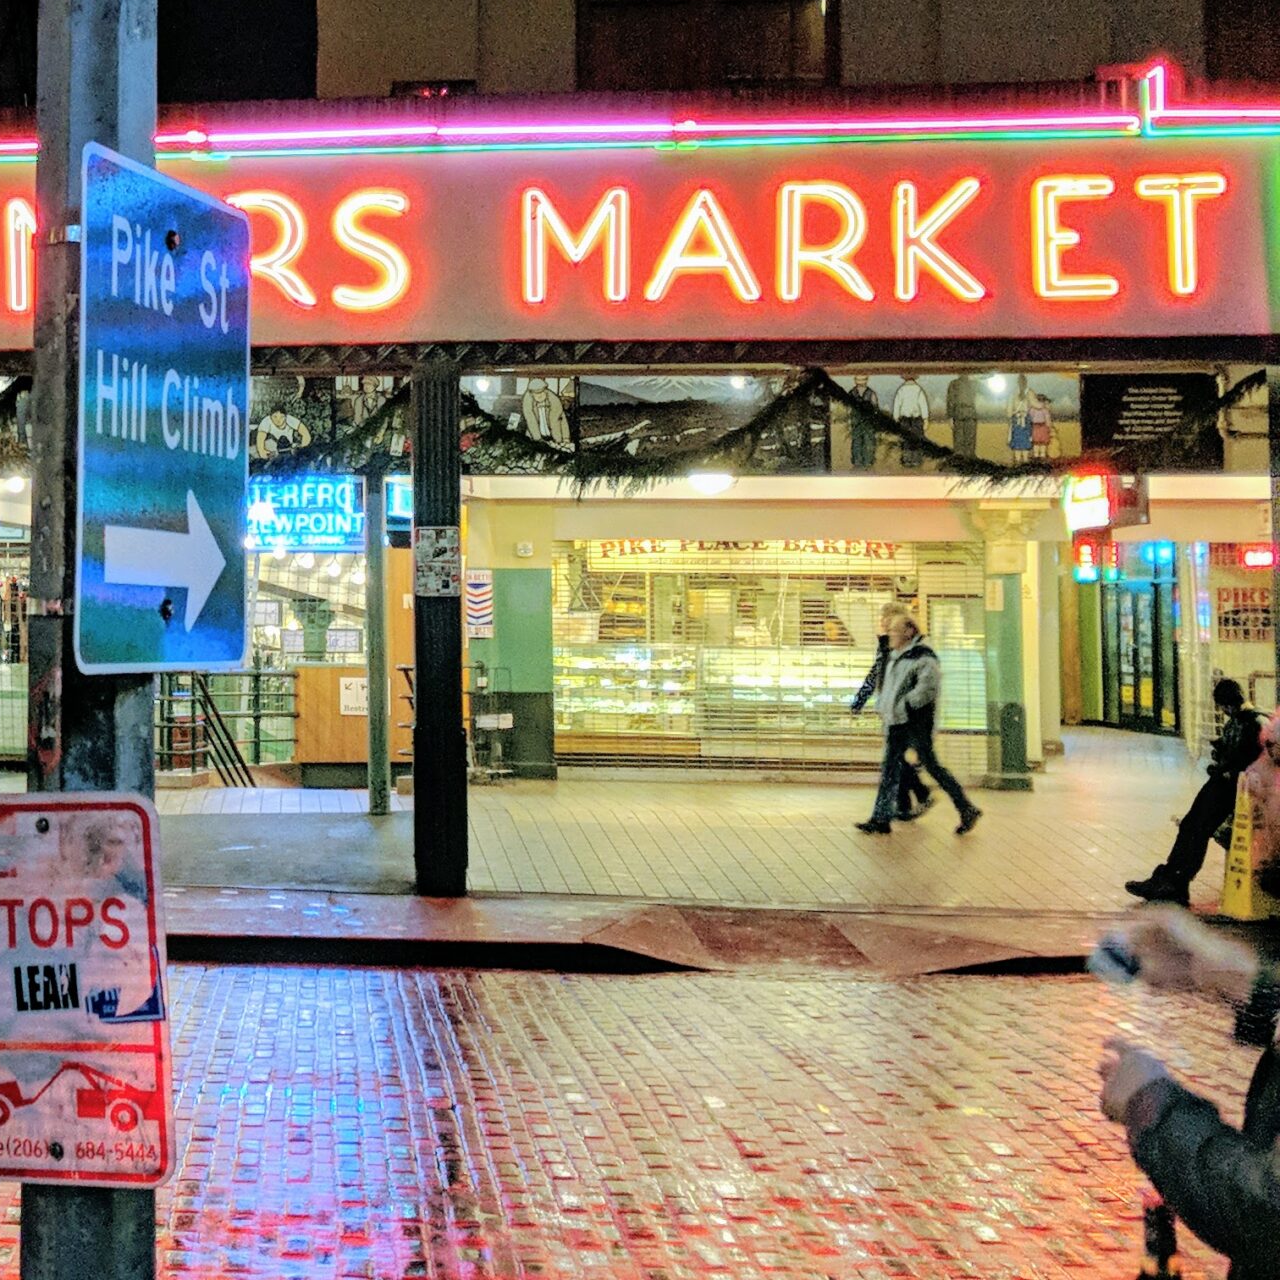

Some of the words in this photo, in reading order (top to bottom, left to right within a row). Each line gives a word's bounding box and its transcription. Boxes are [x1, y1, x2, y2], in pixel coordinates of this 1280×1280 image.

[111, 215, 176, 317] Pike
[198, 251, 231, 335] St
[521, 174, 1227, 305] MARKET
[95, 348, 148, 444] Hill
[161, 368, 240, 461] Climb
[600, 539, 666, 559] PIKE
[782, 539, 903, 560] BAKERY
[74, 1138, 158, 1163] 684-5444
